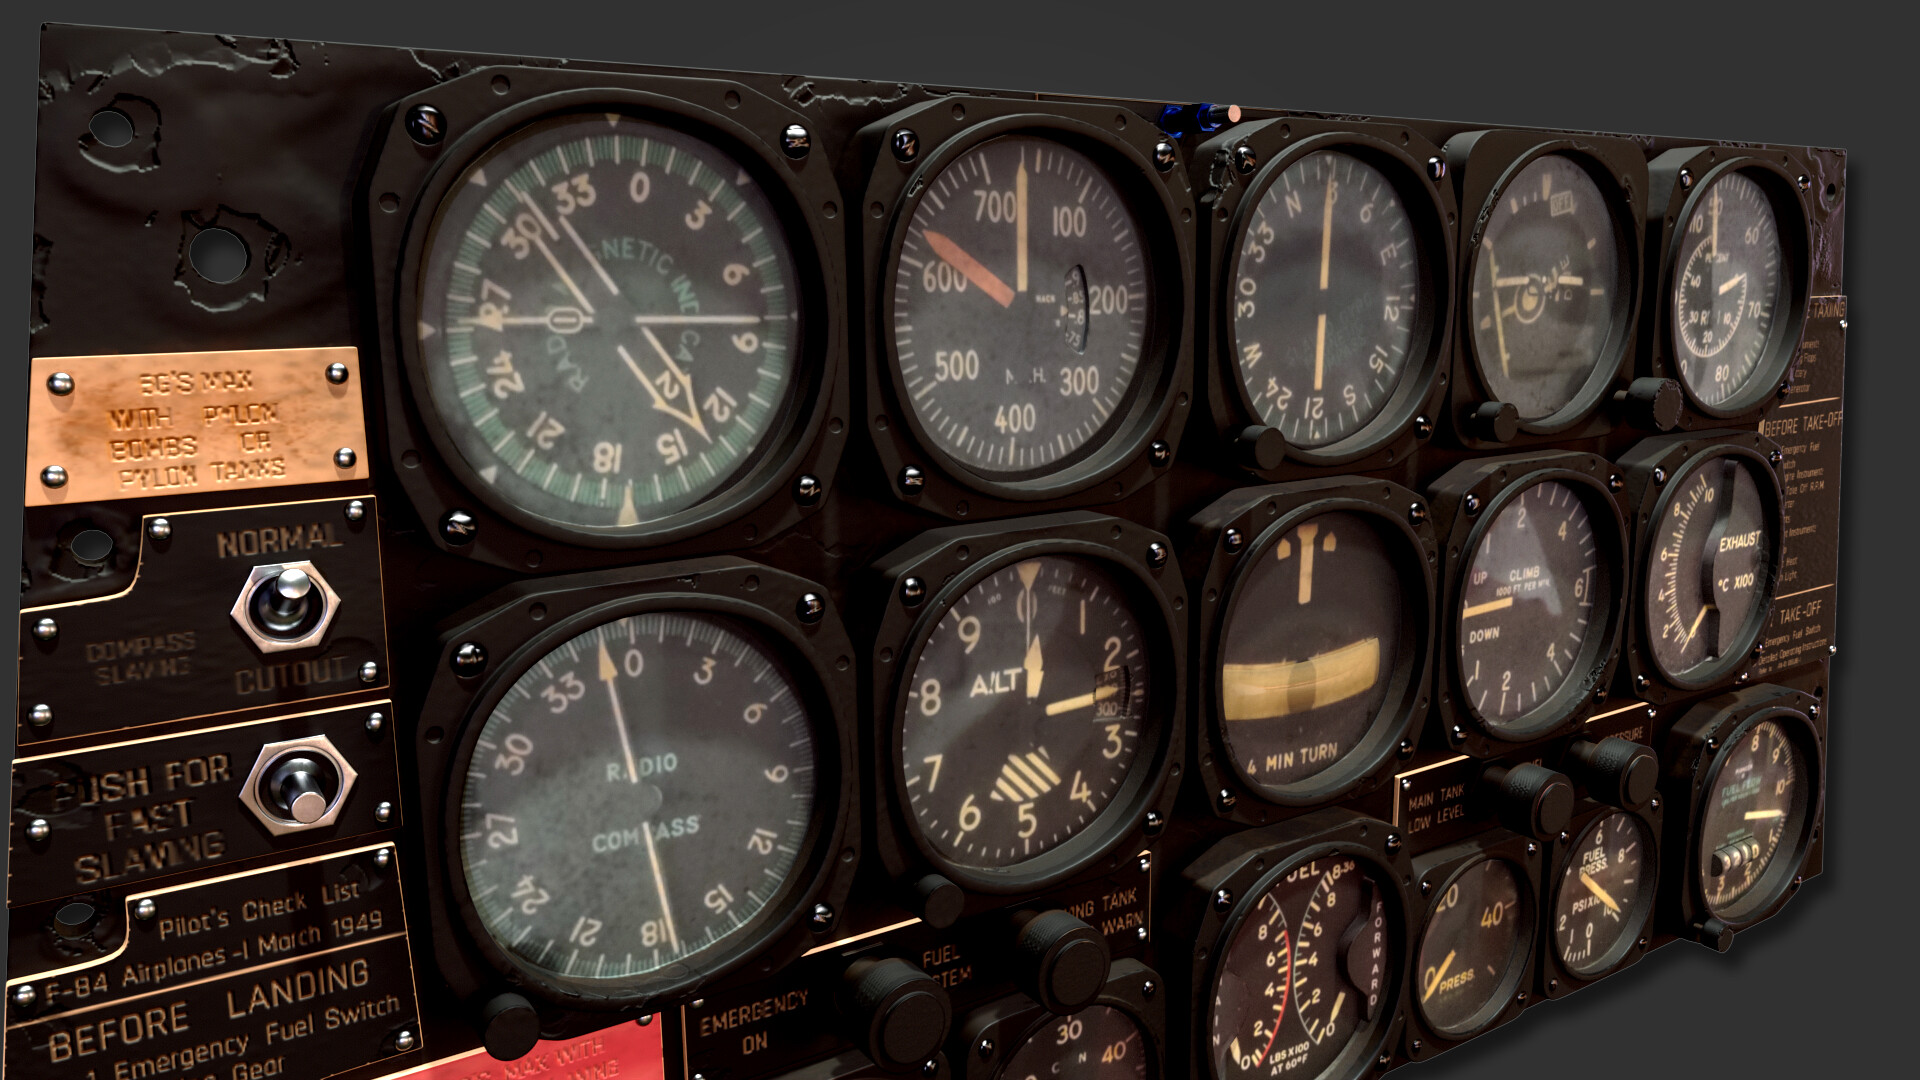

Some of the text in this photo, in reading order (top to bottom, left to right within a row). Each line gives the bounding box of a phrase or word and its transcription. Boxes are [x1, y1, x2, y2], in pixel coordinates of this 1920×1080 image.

[551, 173, 597, 215] 33
[629, 171, 651, 204] 0
[684, 200, 714, 230] 3
[973, 190, 1017, 223] 700
[1285, 189, 1302, 218] N
[1053, 205, 1087, 237] 100
[499, 213, 543, 260] 30
[1247, 220, 1275, 263] 33
[1744, 227, 1760, 245] 60
[598, 237, 675, 276] NETIC
[922, 261, 967, 292] 600
[1690, 275, 1701, 288] 40
[1089, 285, 1128, 315] 200
[1237, 277, 1257, 318] 30
[1384, 295, 1400, 322] 12
[1748, 301, 1761, 318] 70
[1813, 301, 1846, 318] TAXIING
[1689, 310, 1699, 323] 30
[1723, 313, 1731, 325] 10
[1703, 331, 1713, 344] 20
[935, 349, 979, 382] 500
[1369, 344, 1388, 374] 15
[486, 350, 525, 399] 24
[1059, 365, 1099, 396] 300
[1715, 365, 1730, 382] 80
[702, 386, 739, 423] 12
[1266, 376, 1293, 410] 24
[106, 406, 174, 432] WITH
[994, 403, 1036, 433] 400
[1304, 396, 1324, 420] 21
[527, 411, 566, 451] 21
[1764, 411, 1842, 438] BEFORE TAKE-OFF
[108, 435, 199, 463] BOMBS
[593, 442, 623, 474] 18
[656, 428, 690, 464] 15
[1782, 441, 1820, 456] Emergency Fuel
[119, 465, 200, 493] PYLON
[1704, 487, 1715, 503] 10
[1516, 506, 1527, 529] 2
[1673, 502, 1682, 517] 8
[216, 522, 346, 560] NORMAL
[1558, 520, 1568, 542] 4
[1719, 529, 1762, 554] EXHAUST
[1472, 571, 1489, 586] UP
[1509, 565, 1541, 583] CLIMB
[1733, 572, 1755, 590] X100
[1496, 580, 1538, 597] 1000 PER
[1780, 600, 1823, 625] TAKE-OFF
[85, 631, 197, 664] COMPASS
[957, 615, 982, 655] 9
[1469, 626, 1501, 645] DOWN
[1765, 635, 1790, 648] Emergency
[1793, 629, 1803, 641] Fuel
[624, 649, 644, 678] 0
[1103, 636, 1122, 672] 2
[1546, 642, 1556, 662] 4
[234, 656, 349, 695] CUTOUT
[693, 657, 717, 685] 3
[1502, 670, 1512, 692] 2
[540, 671, 587, 715] 33
[920, 678, 942, 717] 8
[494, 733, 534, 777] 30
[1102, 724, 1123, 760] 3
[606, 752, 679, 782] RDIO
[1265, 742, 1339, 774] MIN TURN
[54, 752, 232, 812] PUSH FOR
[923, 754, 943, 793] 7
[1069, 770, 1092, 804] 4
[1775, 779, 1785, 796] 10
[1408, 783, 1466, 812] MAIN TANK
[104, 799, 196, 843] FAST
[958, 793, 982, 833] 6
[1017, 802, 1038, 839] 5
[1407, 803, 1465, 835] LOW LEVEL
[484, 813, 519, 849] 27
[592, 815, 701, 853] COMASS
[747, 827, 778, 856] 12
[1582, 846, 1606, 865] FUEL
[1617, 848, 1625, 863] 8
[1286, 860, 1320, 883] UEL
[511, 874, 550, 915] 24
[704, 883, 734, 915] 15
[1101, 886, 1137, 912] TANK
[1326, 891, 1336, 907] 8
[158, 881, 360, 941] Pilot's Check List
[1101, 910, 1144, 936] WARN
[1480, 901, 1504, 928] 40
[569, 915, 602, 947] 21
[1258, 923, 1268, 941] 8
[1313, 921, 1322, 937] 6
[45, 909, 383, 1005] F-84 Airplanes March 1949
[922, 944, 961, 968] FUEL
[1266, 951, 1276, 967] 6
[1308, 951, 1318, 967] 4
[1369, 900, 1383, 1007] FORWARD
[1264, 981, 1275, 998] 4
[1311, 988, 1321, 1005] 2
[48, 957, 370, 1063] BEFORE LANDING
[701, 988, 809, 1038] EMERGENCY
[113, 994, 401, 1080] Emergency Fuel Switch
[1056, 1018, 1083, 1046] 30
[1253, 1020, 1264, 1037] 2
[1325, 1021, 1335, 1037] 0
[742, 1030, 768, 1056] ON
[1101, 1040, 1127, 1065] 40
[1269, 1041, 1310, 1065] LBS X100
[232, 1055, 287, 1080] Gear
[1240, 1054, 1251, 1071] 0
[1270, 1060, 1284, 1077] AT
